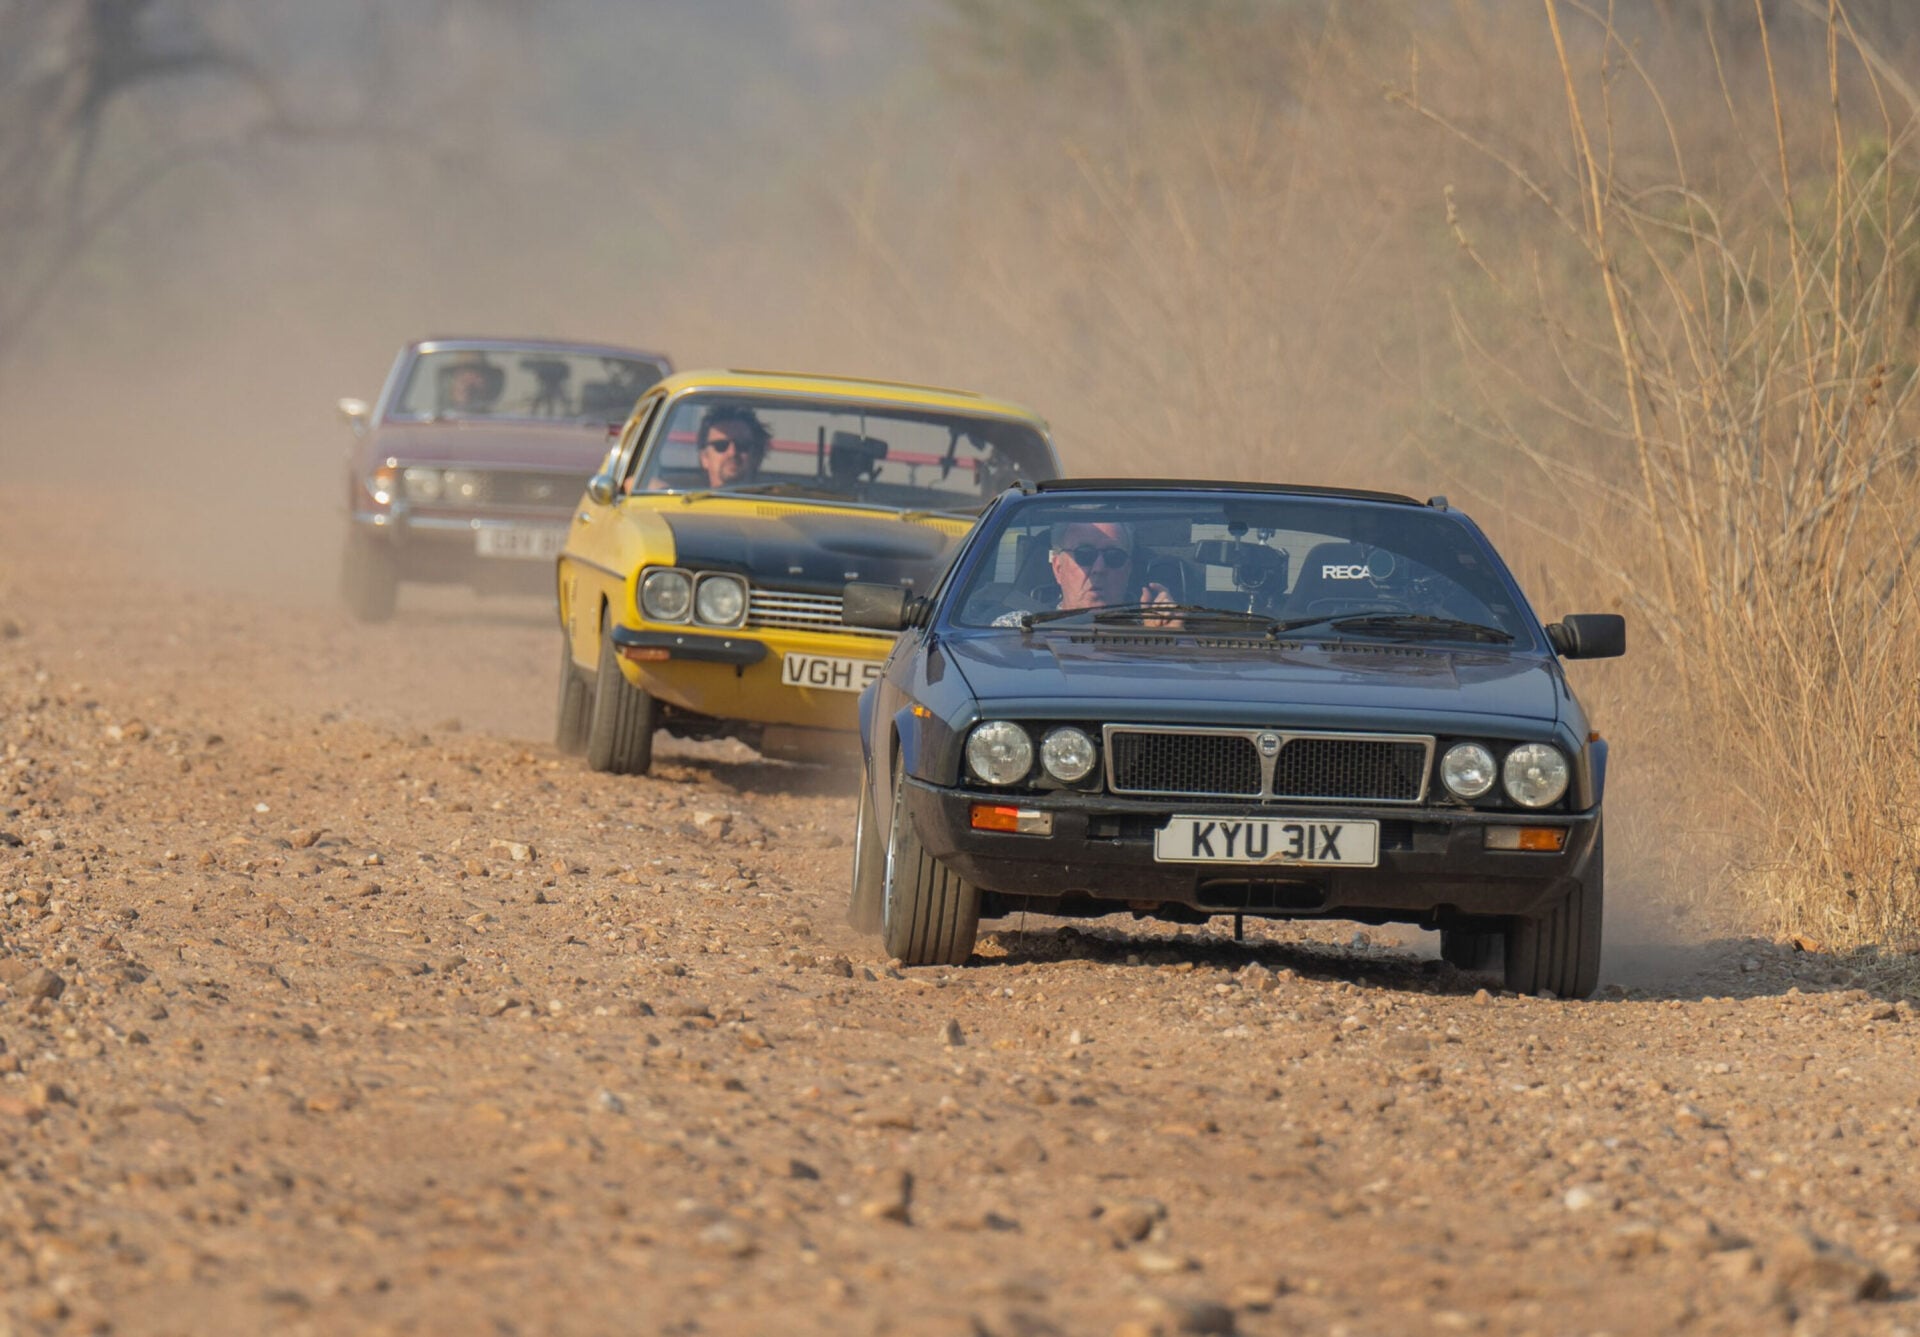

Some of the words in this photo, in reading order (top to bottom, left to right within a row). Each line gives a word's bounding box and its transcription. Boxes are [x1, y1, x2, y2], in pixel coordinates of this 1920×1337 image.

[788, 656, 852, 688] VGH
[1191, 821, 1269, 858] KYU
[1282, 824, 1342, 860] 31X
